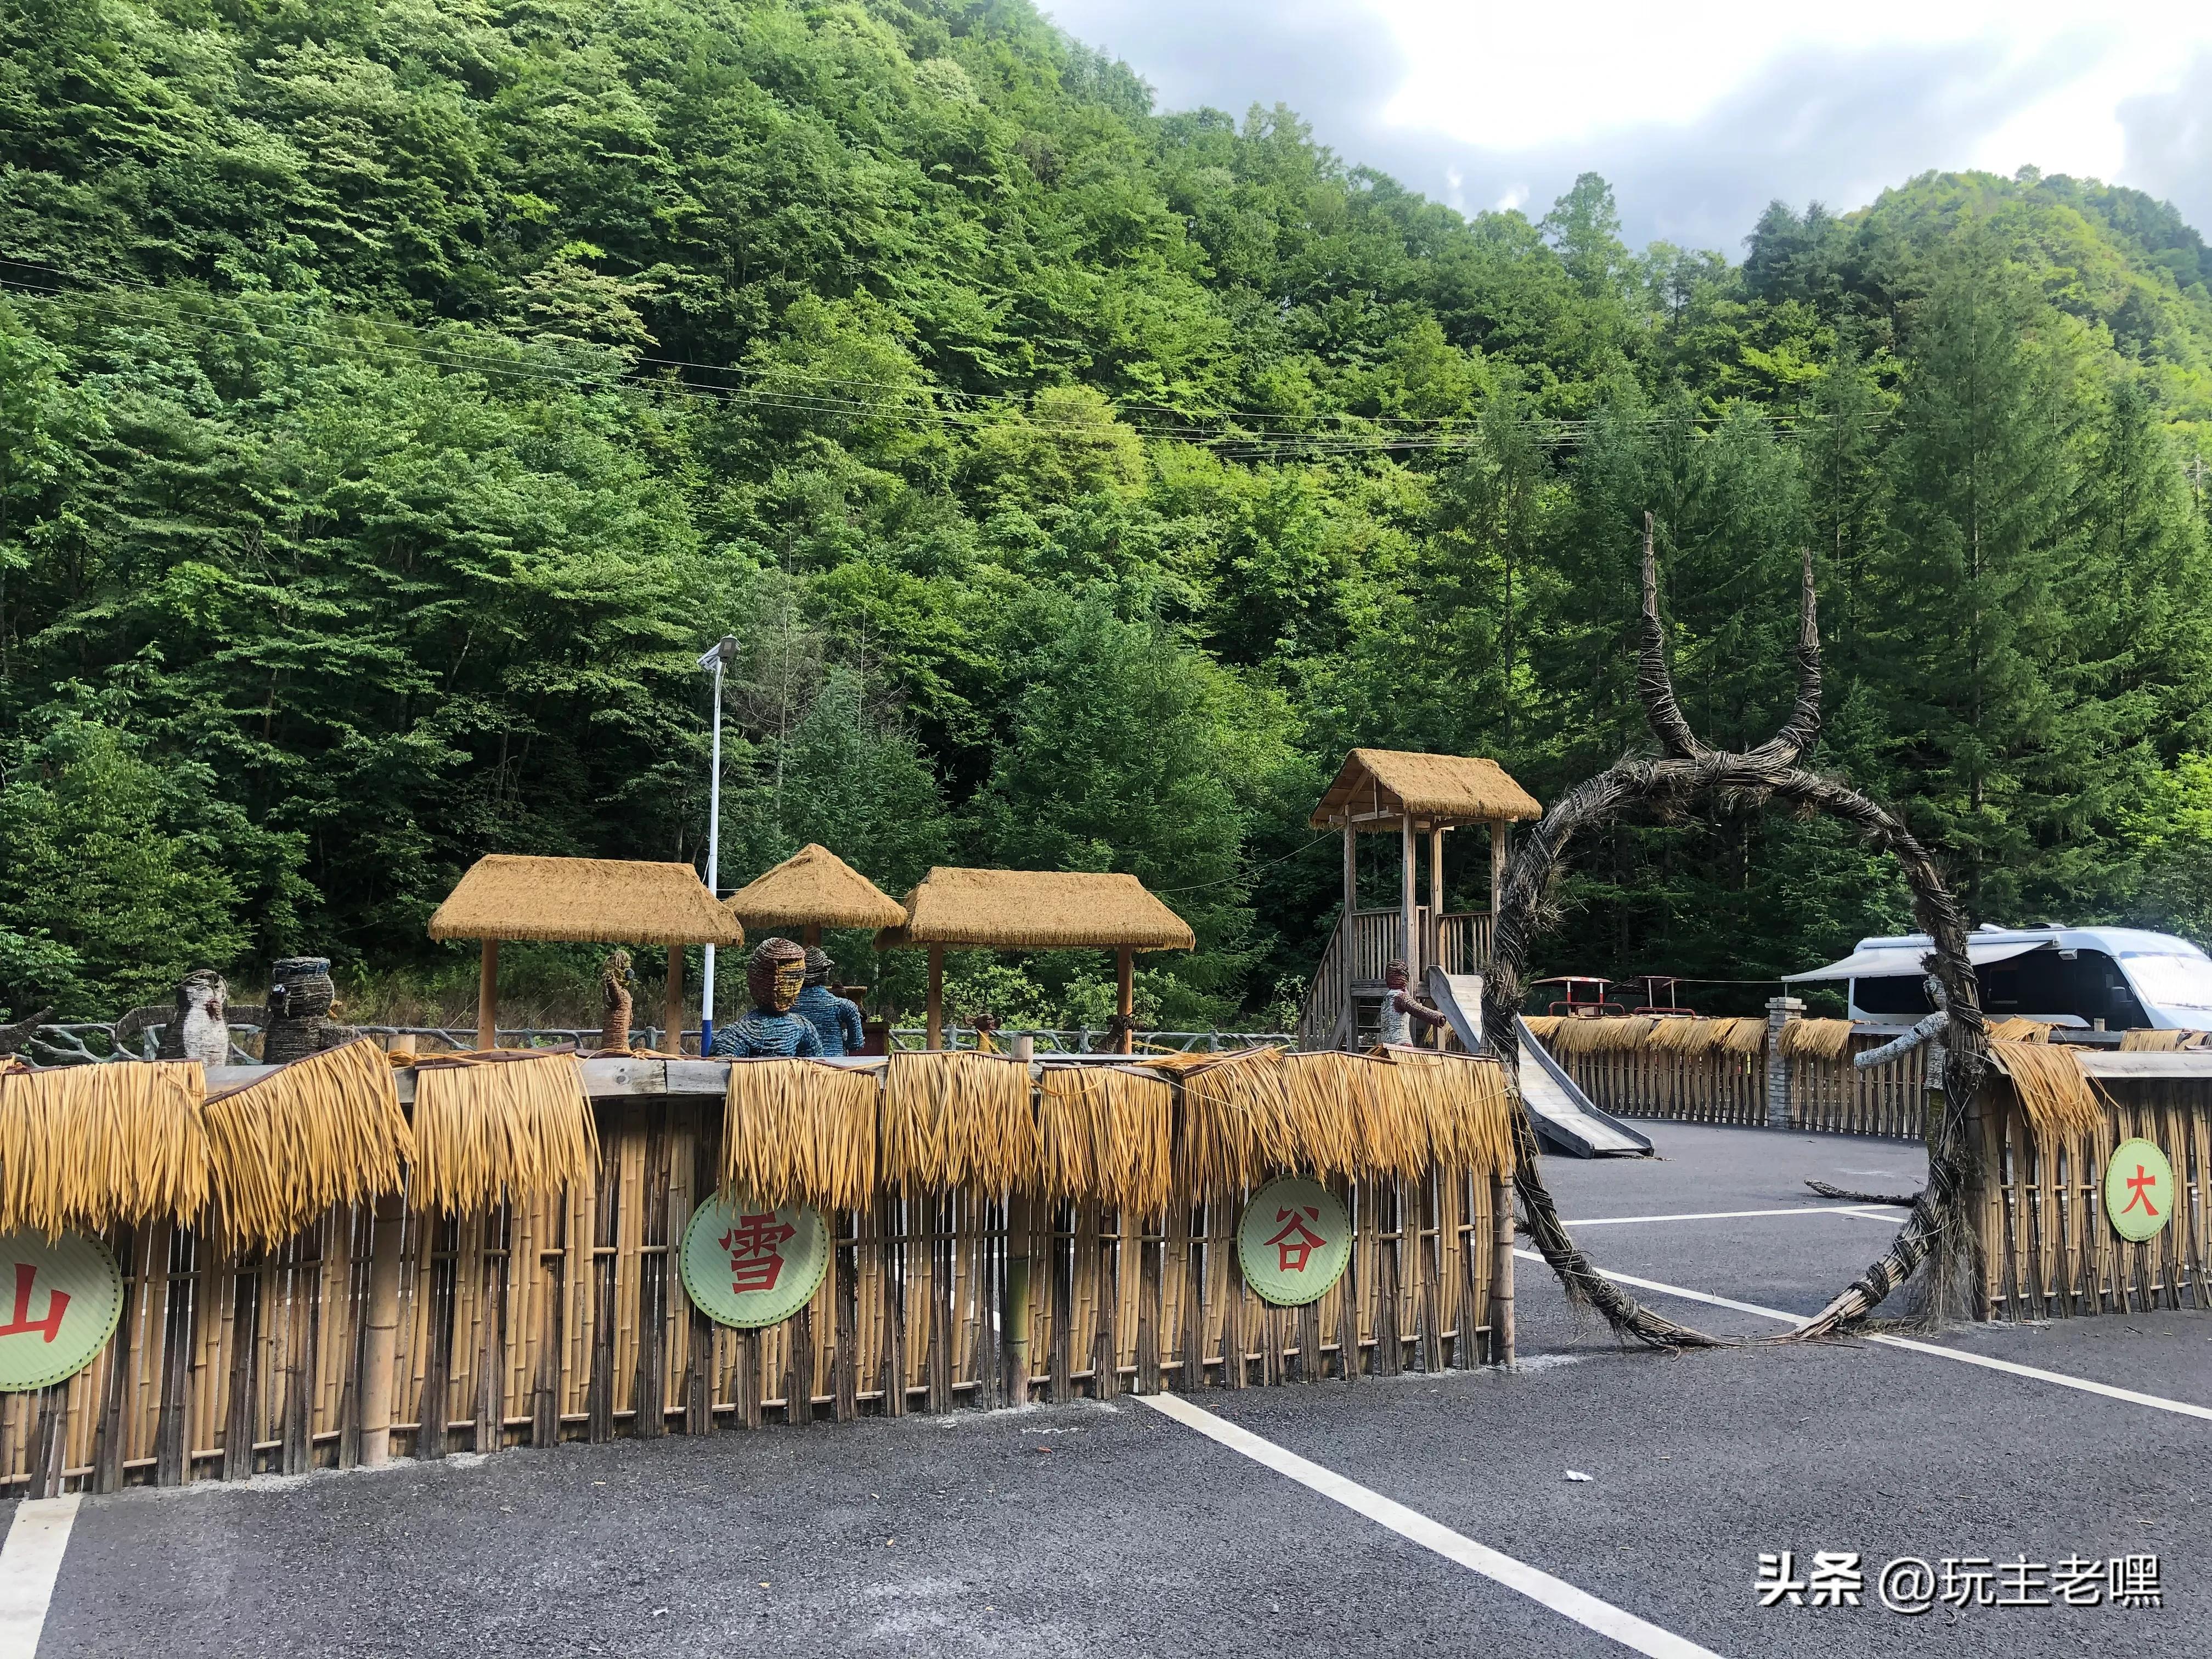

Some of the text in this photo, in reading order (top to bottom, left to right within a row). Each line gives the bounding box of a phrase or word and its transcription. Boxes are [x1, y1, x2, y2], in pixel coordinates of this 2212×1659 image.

[2121, 1164, 2159, 1216] 大
[718, 1211, 796, 1294] 雪
[1263, 1206, 1327, 1272] 谷
